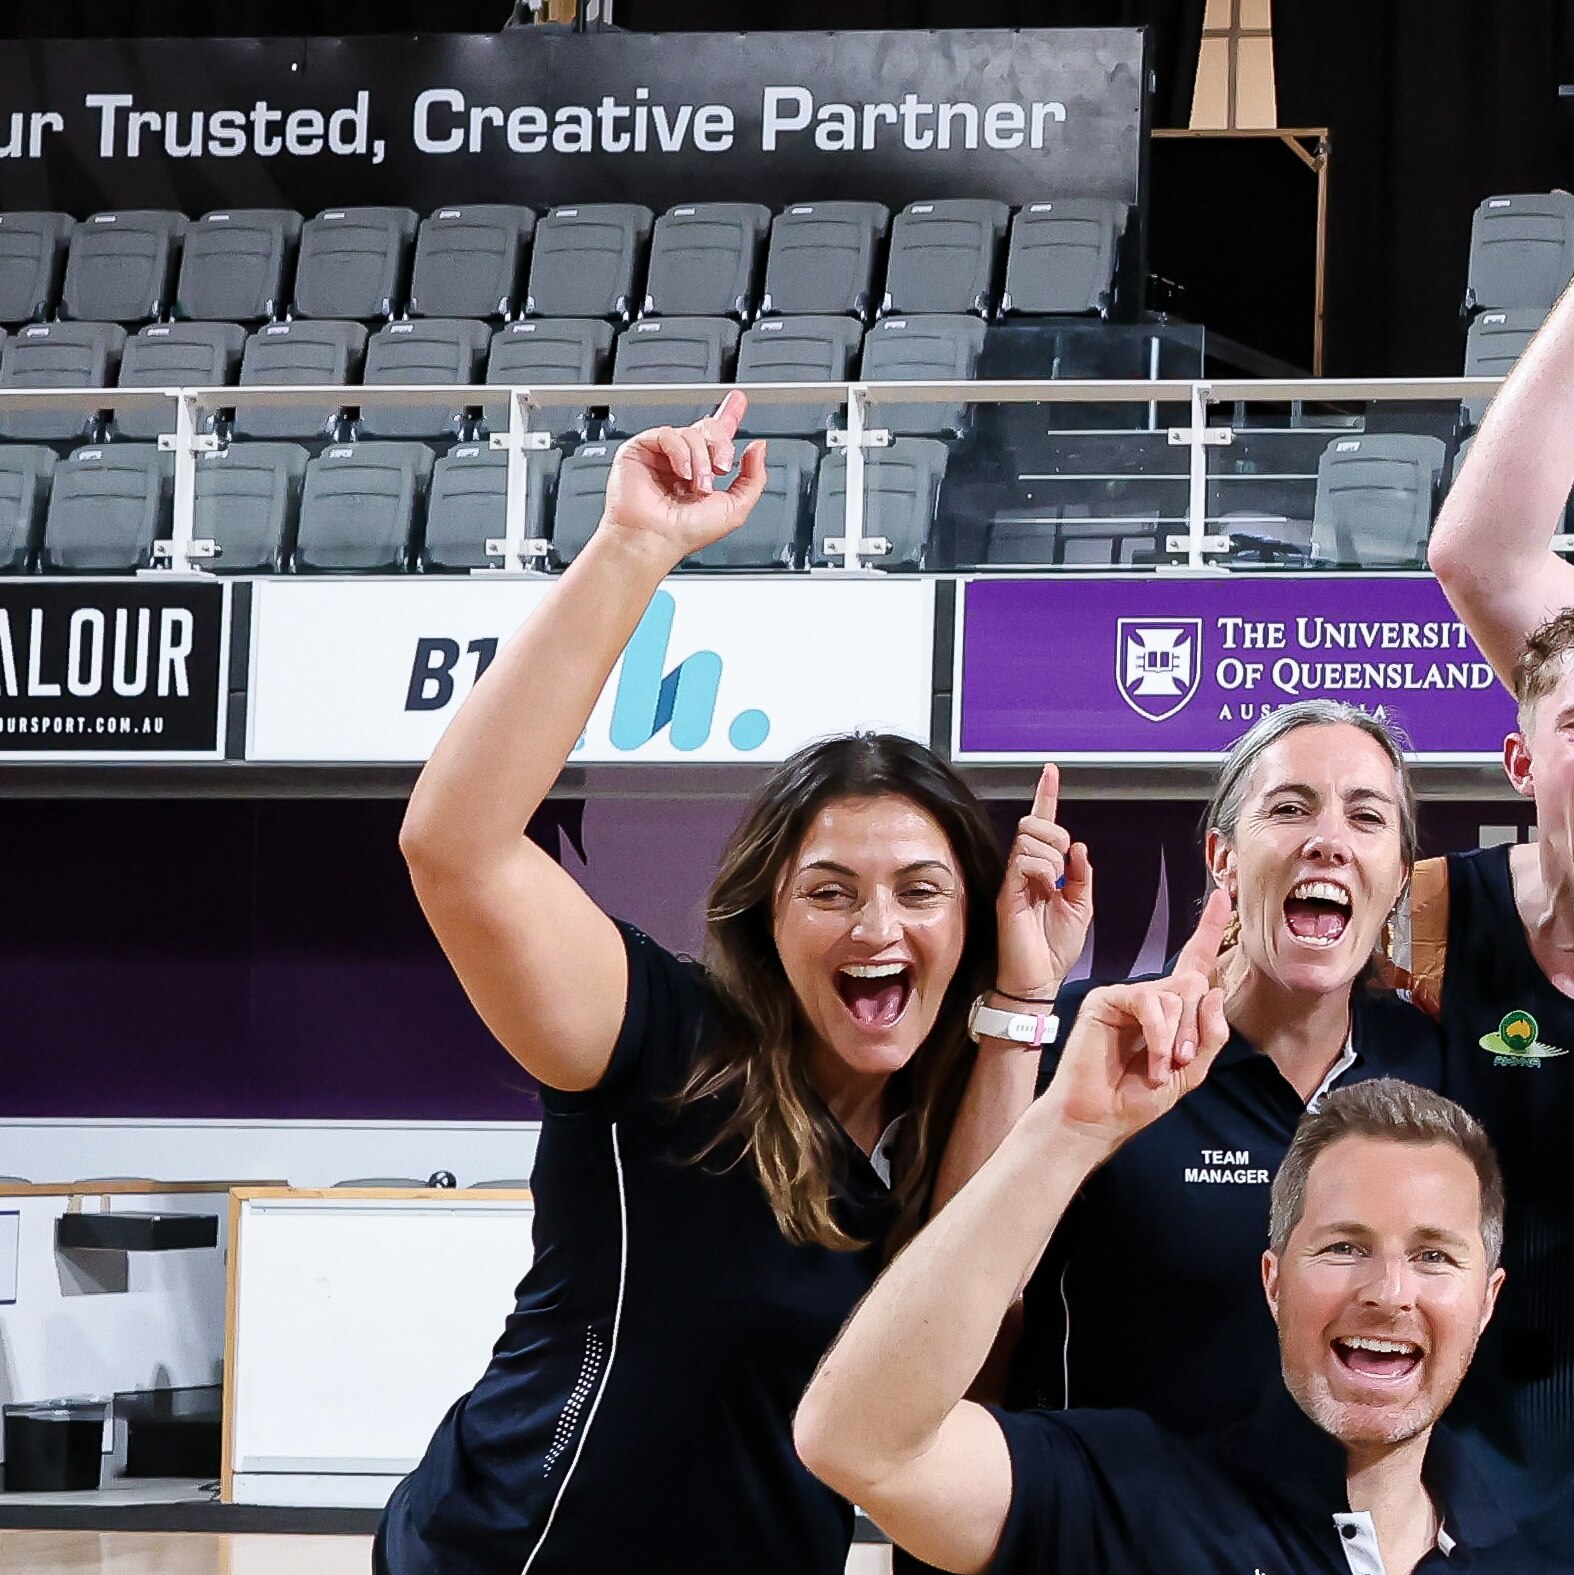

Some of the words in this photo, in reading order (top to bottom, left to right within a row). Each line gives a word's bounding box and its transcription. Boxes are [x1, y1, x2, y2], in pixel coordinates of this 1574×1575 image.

[85, 90, 386, 164] Trusted,
[413, 87, 735, 154] Creative
[761, 85, 1068, 152] Partner
[1216, 617, 1286, 650] THE
[1297, 617, 1470, 650] UNIVERSIT
[1215, 657, 1264, 690] OF
[1272, 657, 1495, 695] QUEENSLAND
[1201, 1150, 1249, 1165] TEAM
[1185, 1168, 1269, 1184] MANAGER
